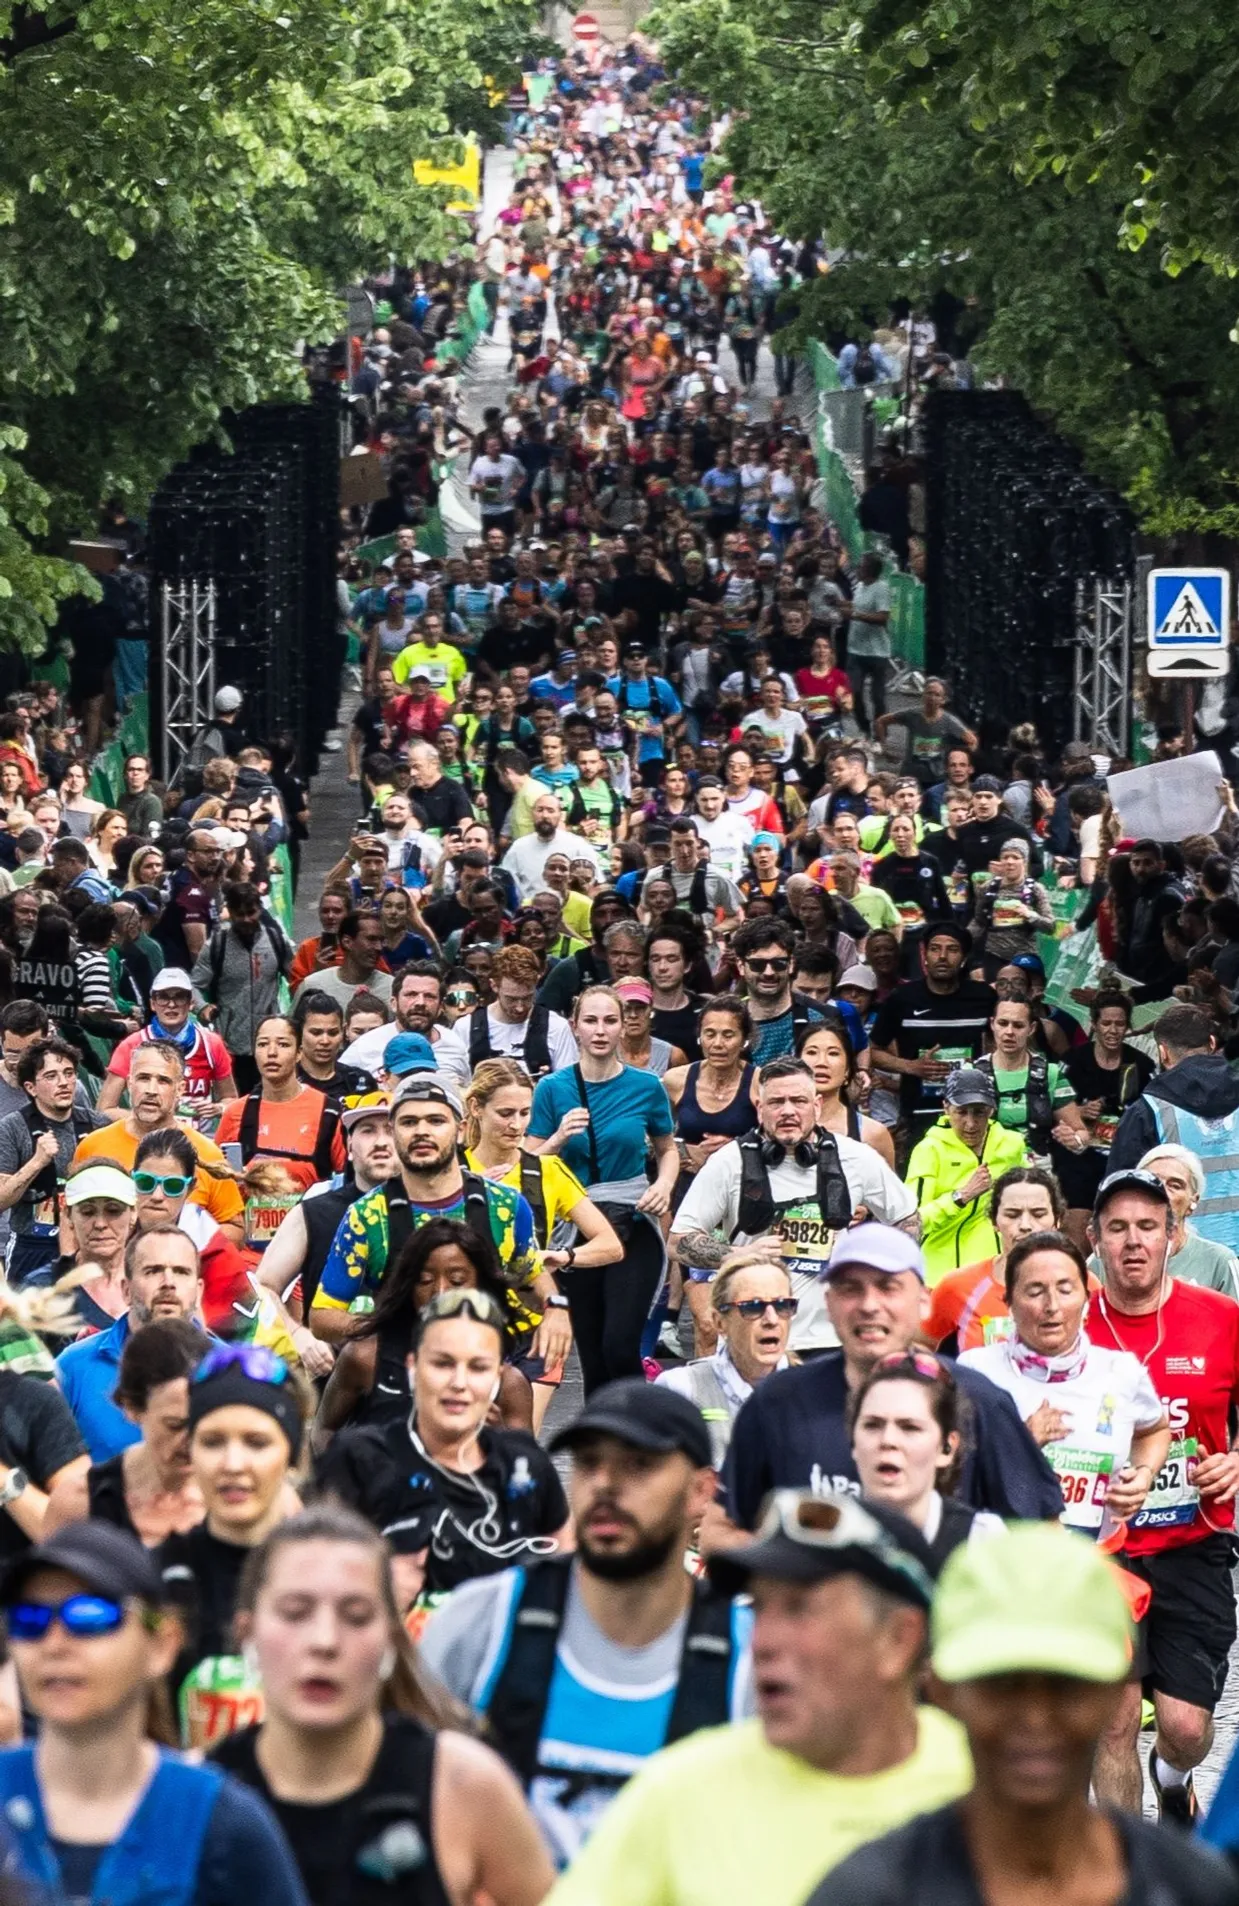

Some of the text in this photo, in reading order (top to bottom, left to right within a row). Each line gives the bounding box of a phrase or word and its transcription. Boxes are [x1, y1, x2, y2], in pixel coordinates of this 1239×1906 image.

[18, 961, 74, 988] RAVO
[779, 1219, 829, 1245] 69828
[1057, 1473, 1089, 1504] 36
[1149, 1463, 1181, 1492] 52
[1148, 1510, 1177, 1523] asics
